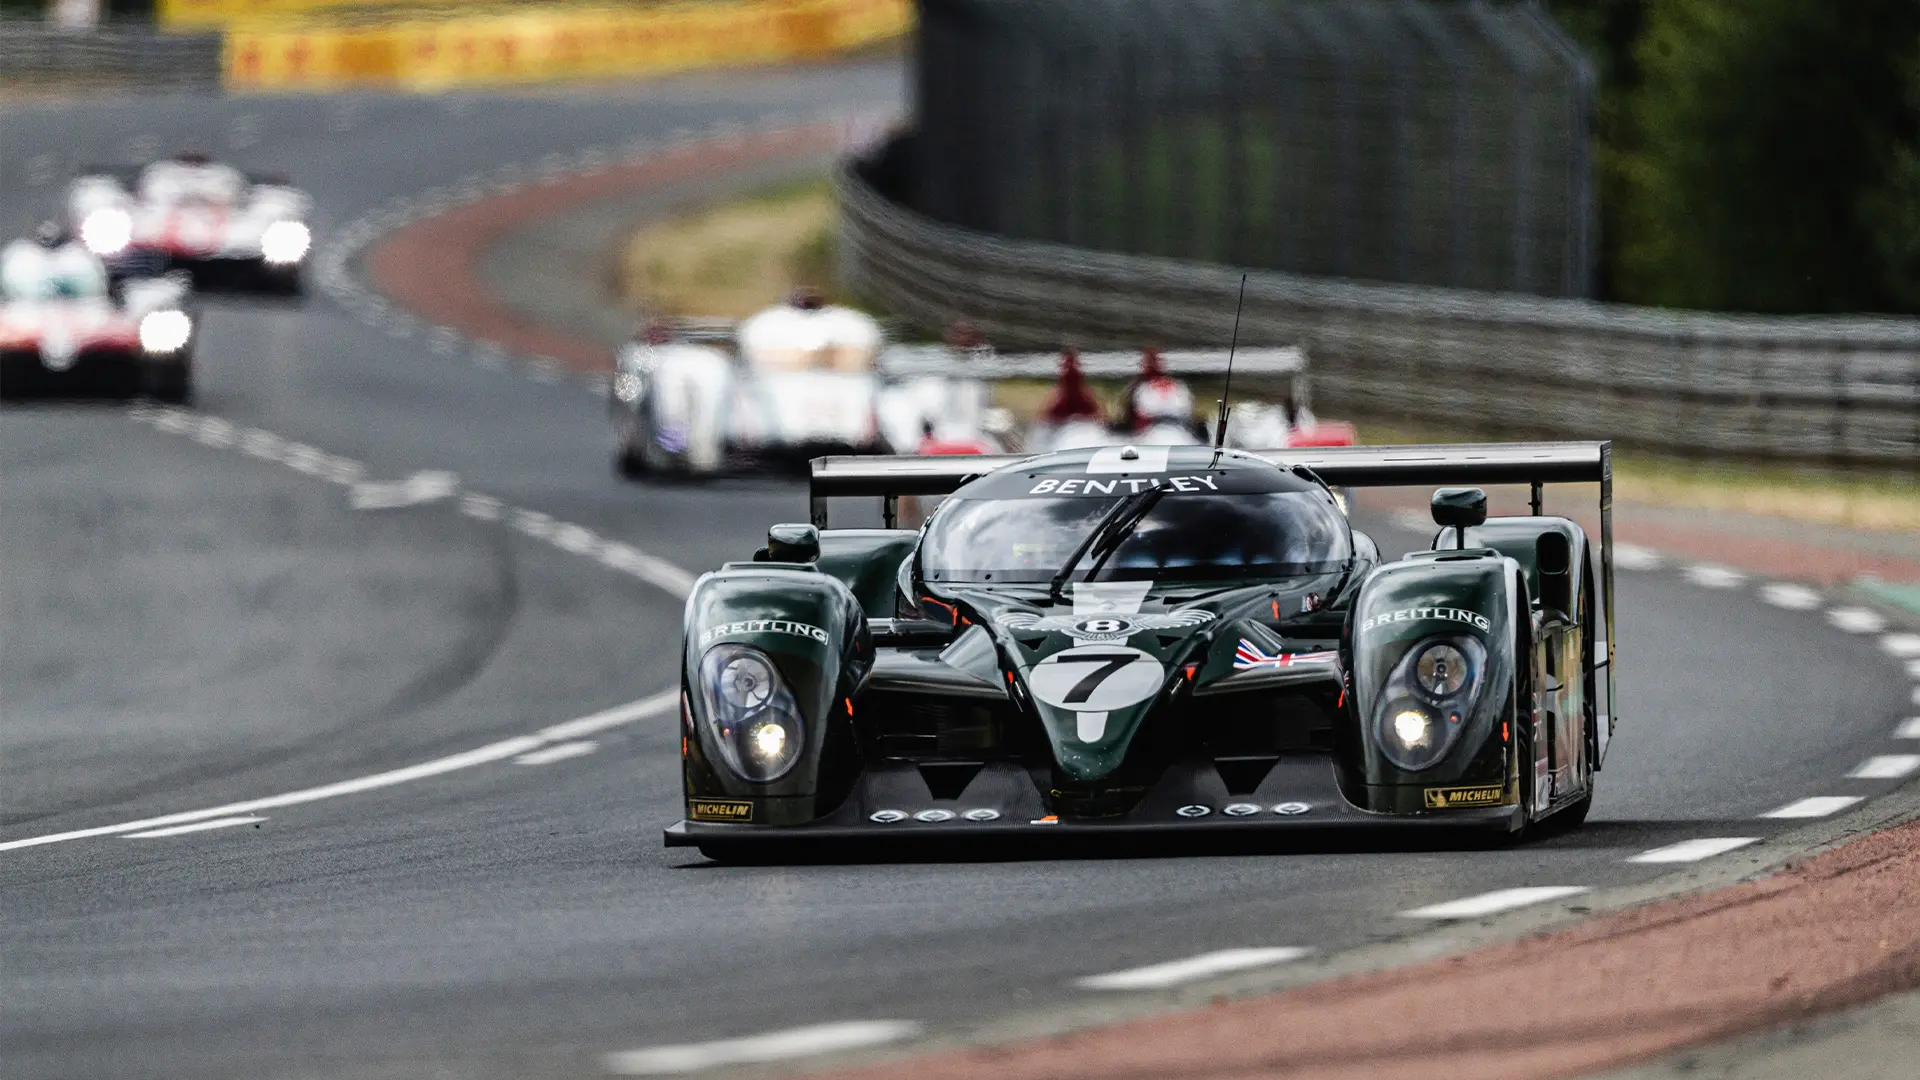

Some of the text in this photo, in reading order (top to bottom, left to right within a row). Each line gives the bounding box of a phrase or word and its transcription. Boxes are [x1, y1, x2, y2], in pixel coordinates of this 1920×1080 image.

[1030, 475, 1218, 494] BENTLEY
[1085, 619, 1121, 632] B
[1363, 608, 1489, 632] BREITLING
[701, 621, 828, 645] BREITLING
[1057, 654, 1140, 703] 7
[1449, 788, 1501, 802] MICHELIN
[697, 804, 749, 815] MICHELIN
